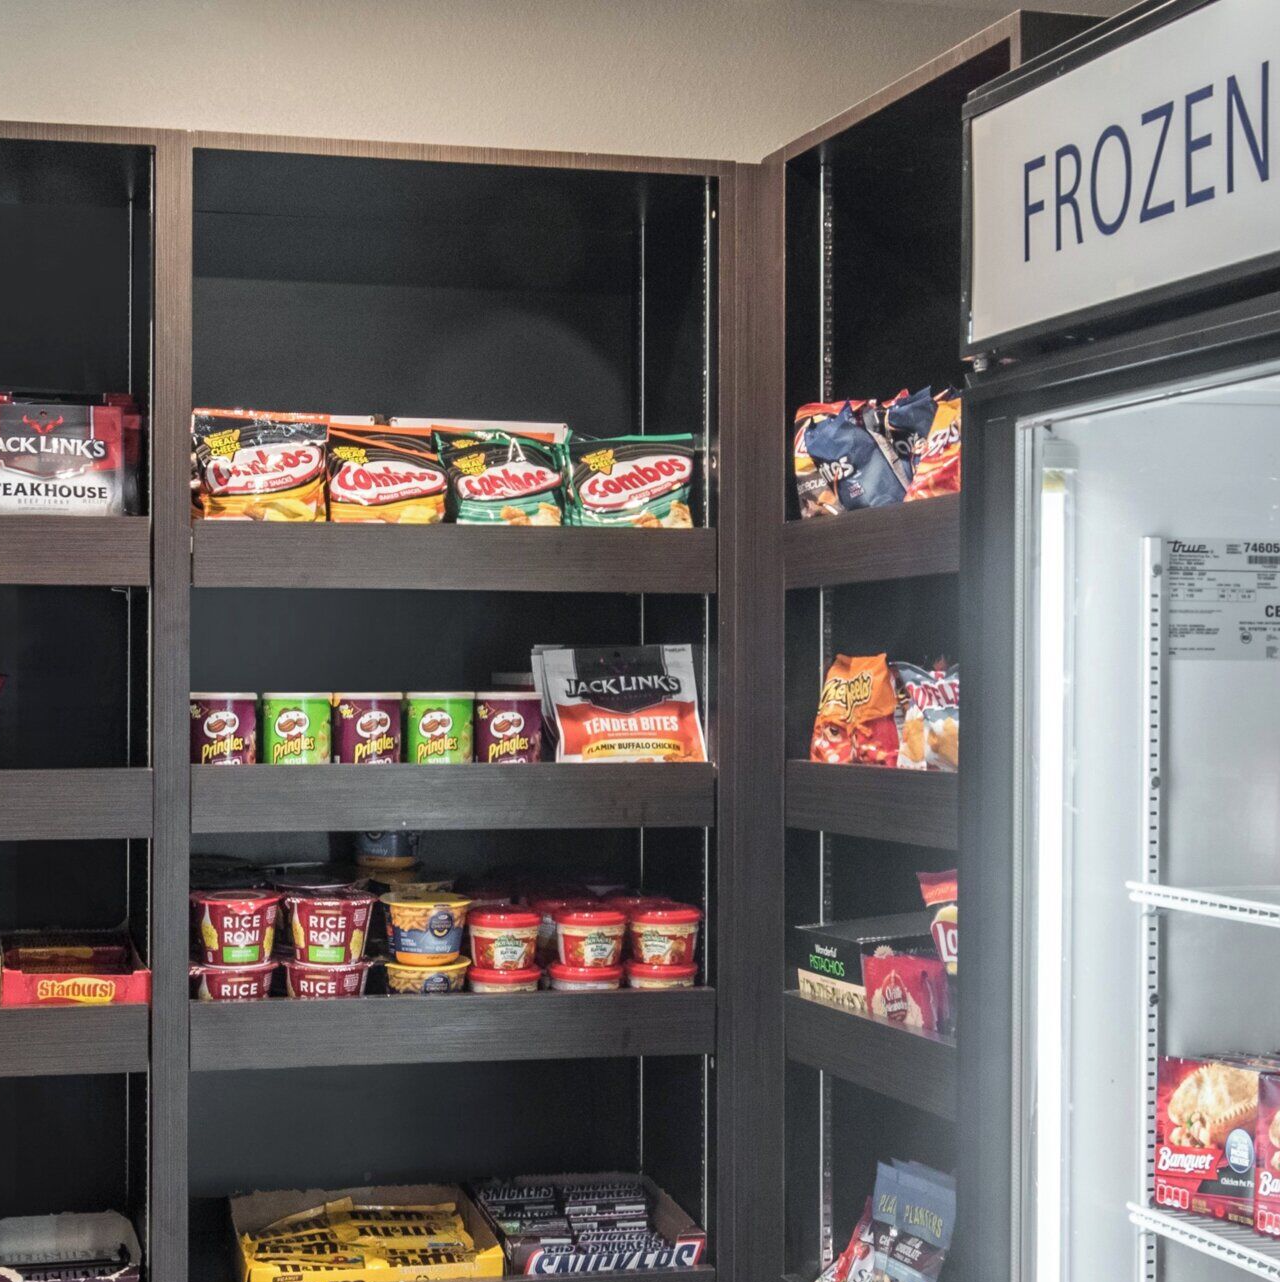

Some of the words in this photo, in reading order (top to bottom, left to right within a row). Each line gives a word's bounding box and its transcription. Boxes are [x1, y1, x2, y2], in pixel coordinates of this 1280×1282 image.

[1024, 60, 1271, 262] FROZEN
[39, 435, 107, 459] LINK'S
[588, 457, 687, 497] Combos
[565, 678, 620, 698] JACK
[619, 674, 680, 692] LINK'S
[583, 717, 639, 735] TENDER
[640, 715, 679, 732] BITES
[201, 735, 244, 762] Pringles
[273, 734, 315, 763] Pringles
[354, 734, 395, 761] Pringles
[416, 734, 459, 763] Pringles
[488, 733, 529, 761] Pringles
[617, 742, 651, 750] BUFFALO
[651, 743, 681, 752] CHICKEN
[223, 915, 261, 928] RICE
[309, 915, 347, 928] RICE
[814, 943, 838, 959] Wonderful
[809, 953, 846, 977] PISTACHIOS
[37, 980, 116, 999] Starburst
[221, 983, 258, 997] RICE
[300, 981, 337, 994] RICE
[1158, 1146, 1215, 1175] Banquet
[483, 1186, 554, 1200] SNICKERS
[1220, 1177, 1238, 1186] Chicken
[534, 1244, 697, 1275] SNICKERS
